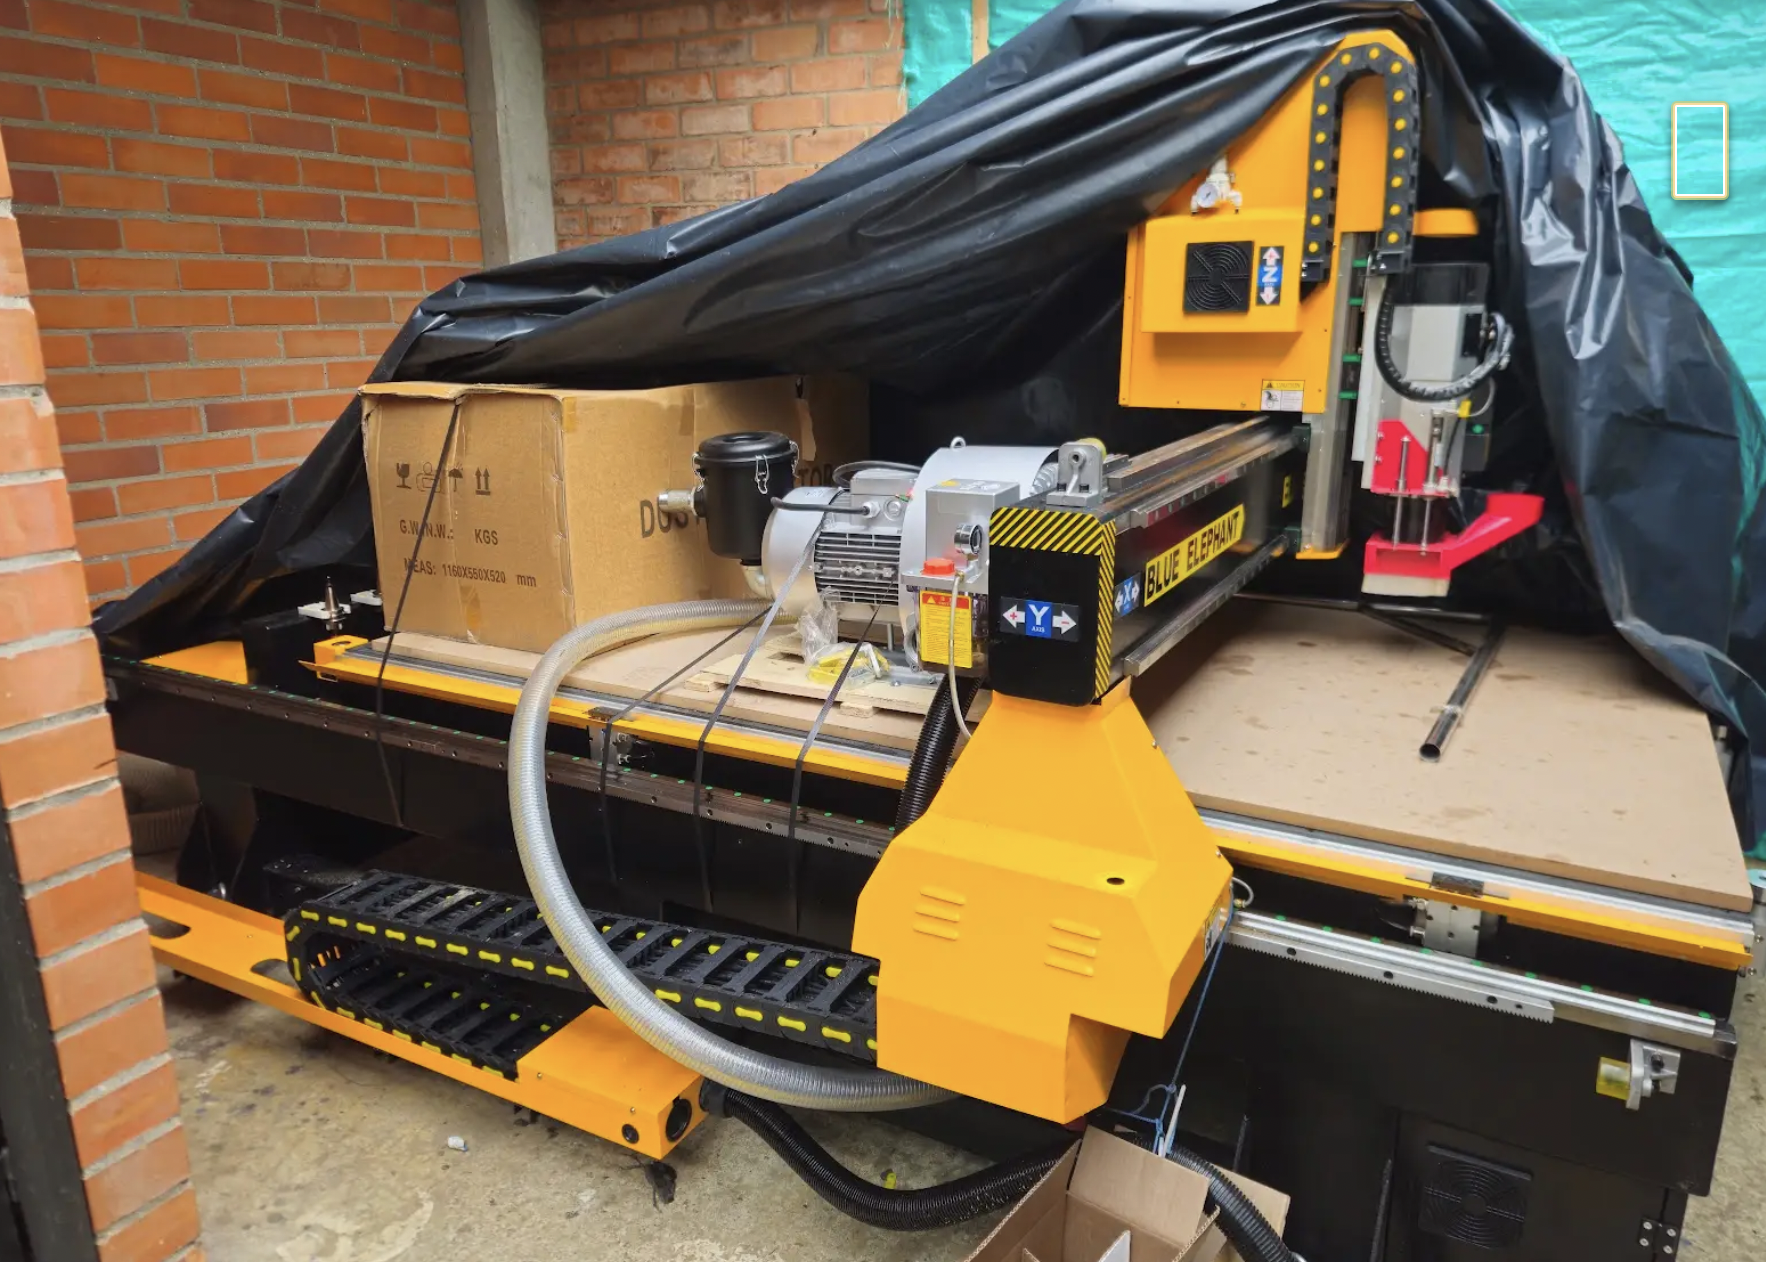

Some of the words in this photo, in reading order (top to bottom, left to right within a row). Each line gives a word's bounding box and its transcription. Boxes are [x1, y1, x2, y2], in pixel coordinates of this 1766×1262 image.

[1262, 266, 1278, 283] Z
[475, 528, 498, 545] KGS
[1147, 548, 1180, 598] BLUE
[1187, 511, 1240, 571] ELEPHANT
[442, 563, 506, 583] 1160X550X520
[516, 573, 537, 587] mm
[1124, 582, 1132, 604] X
[1028, 604, 1050, 626] Y
